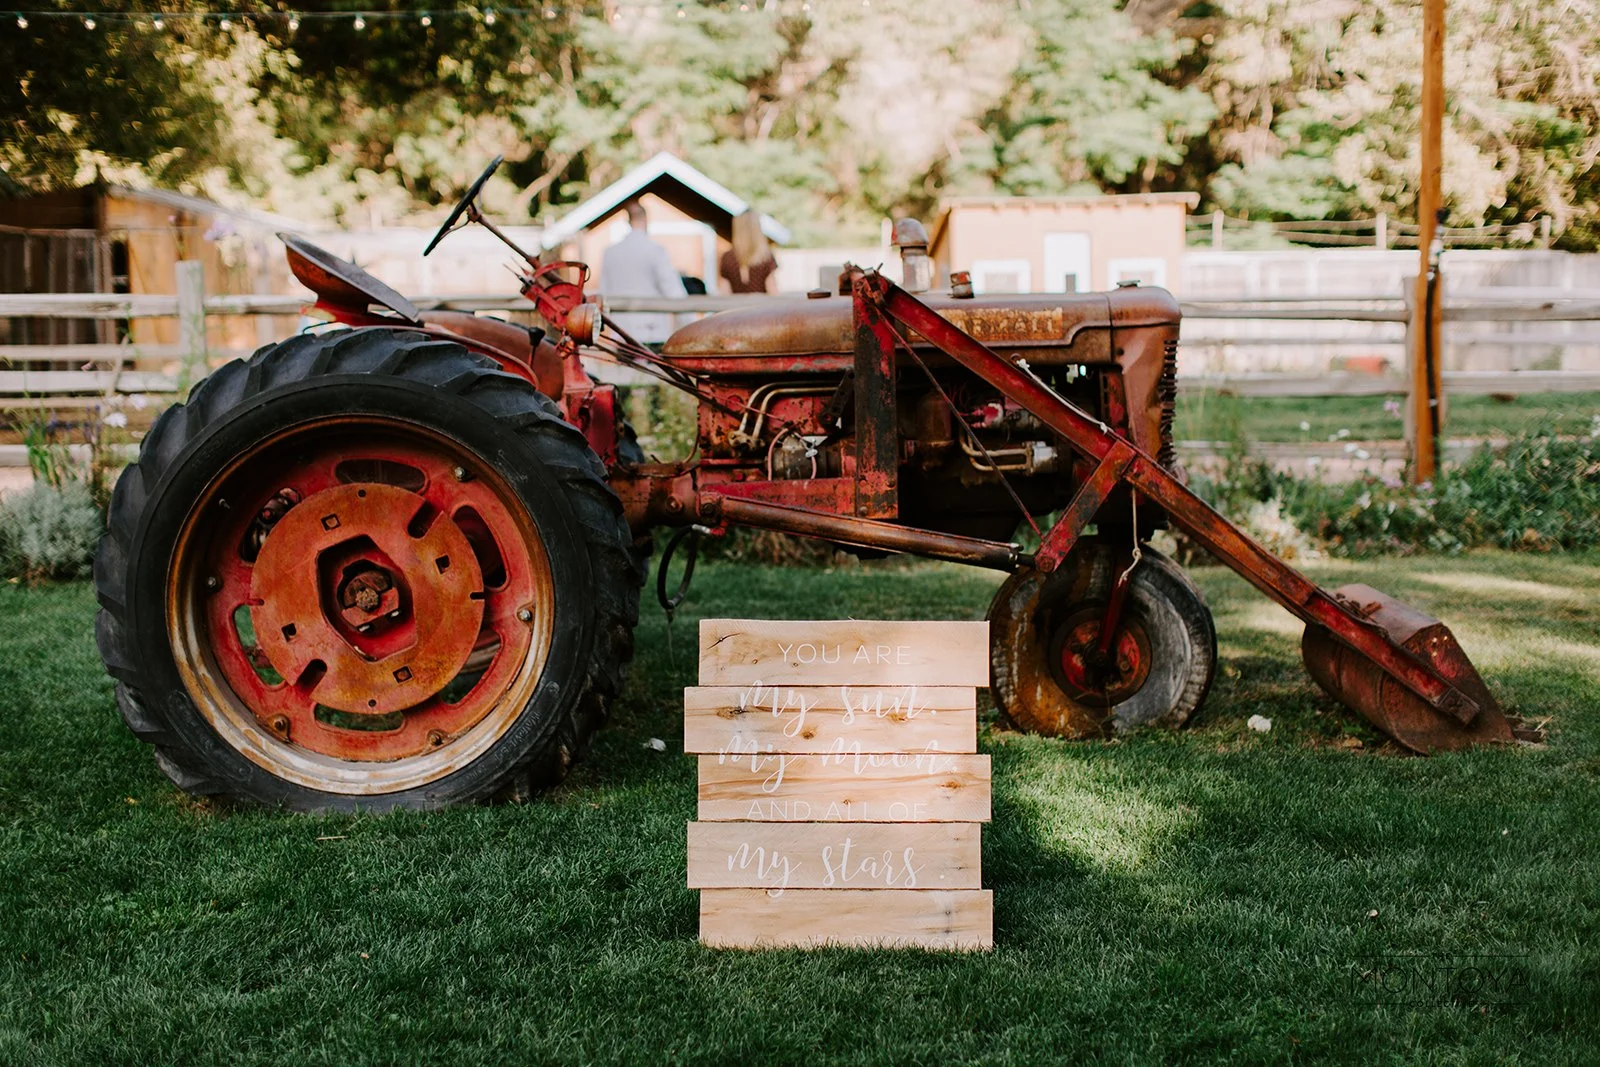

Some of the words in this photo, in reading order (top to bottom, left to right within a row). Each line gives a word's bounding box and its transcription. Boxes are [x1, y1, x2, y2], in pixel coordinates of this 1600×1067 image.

[778, 643, 841, 664] YOU
[853, 645, 911, 665] ARE
[747, 800, 812, 820] AND
[824, 801, 872, 820] ALL
[888, 801, 928, 821] OF
